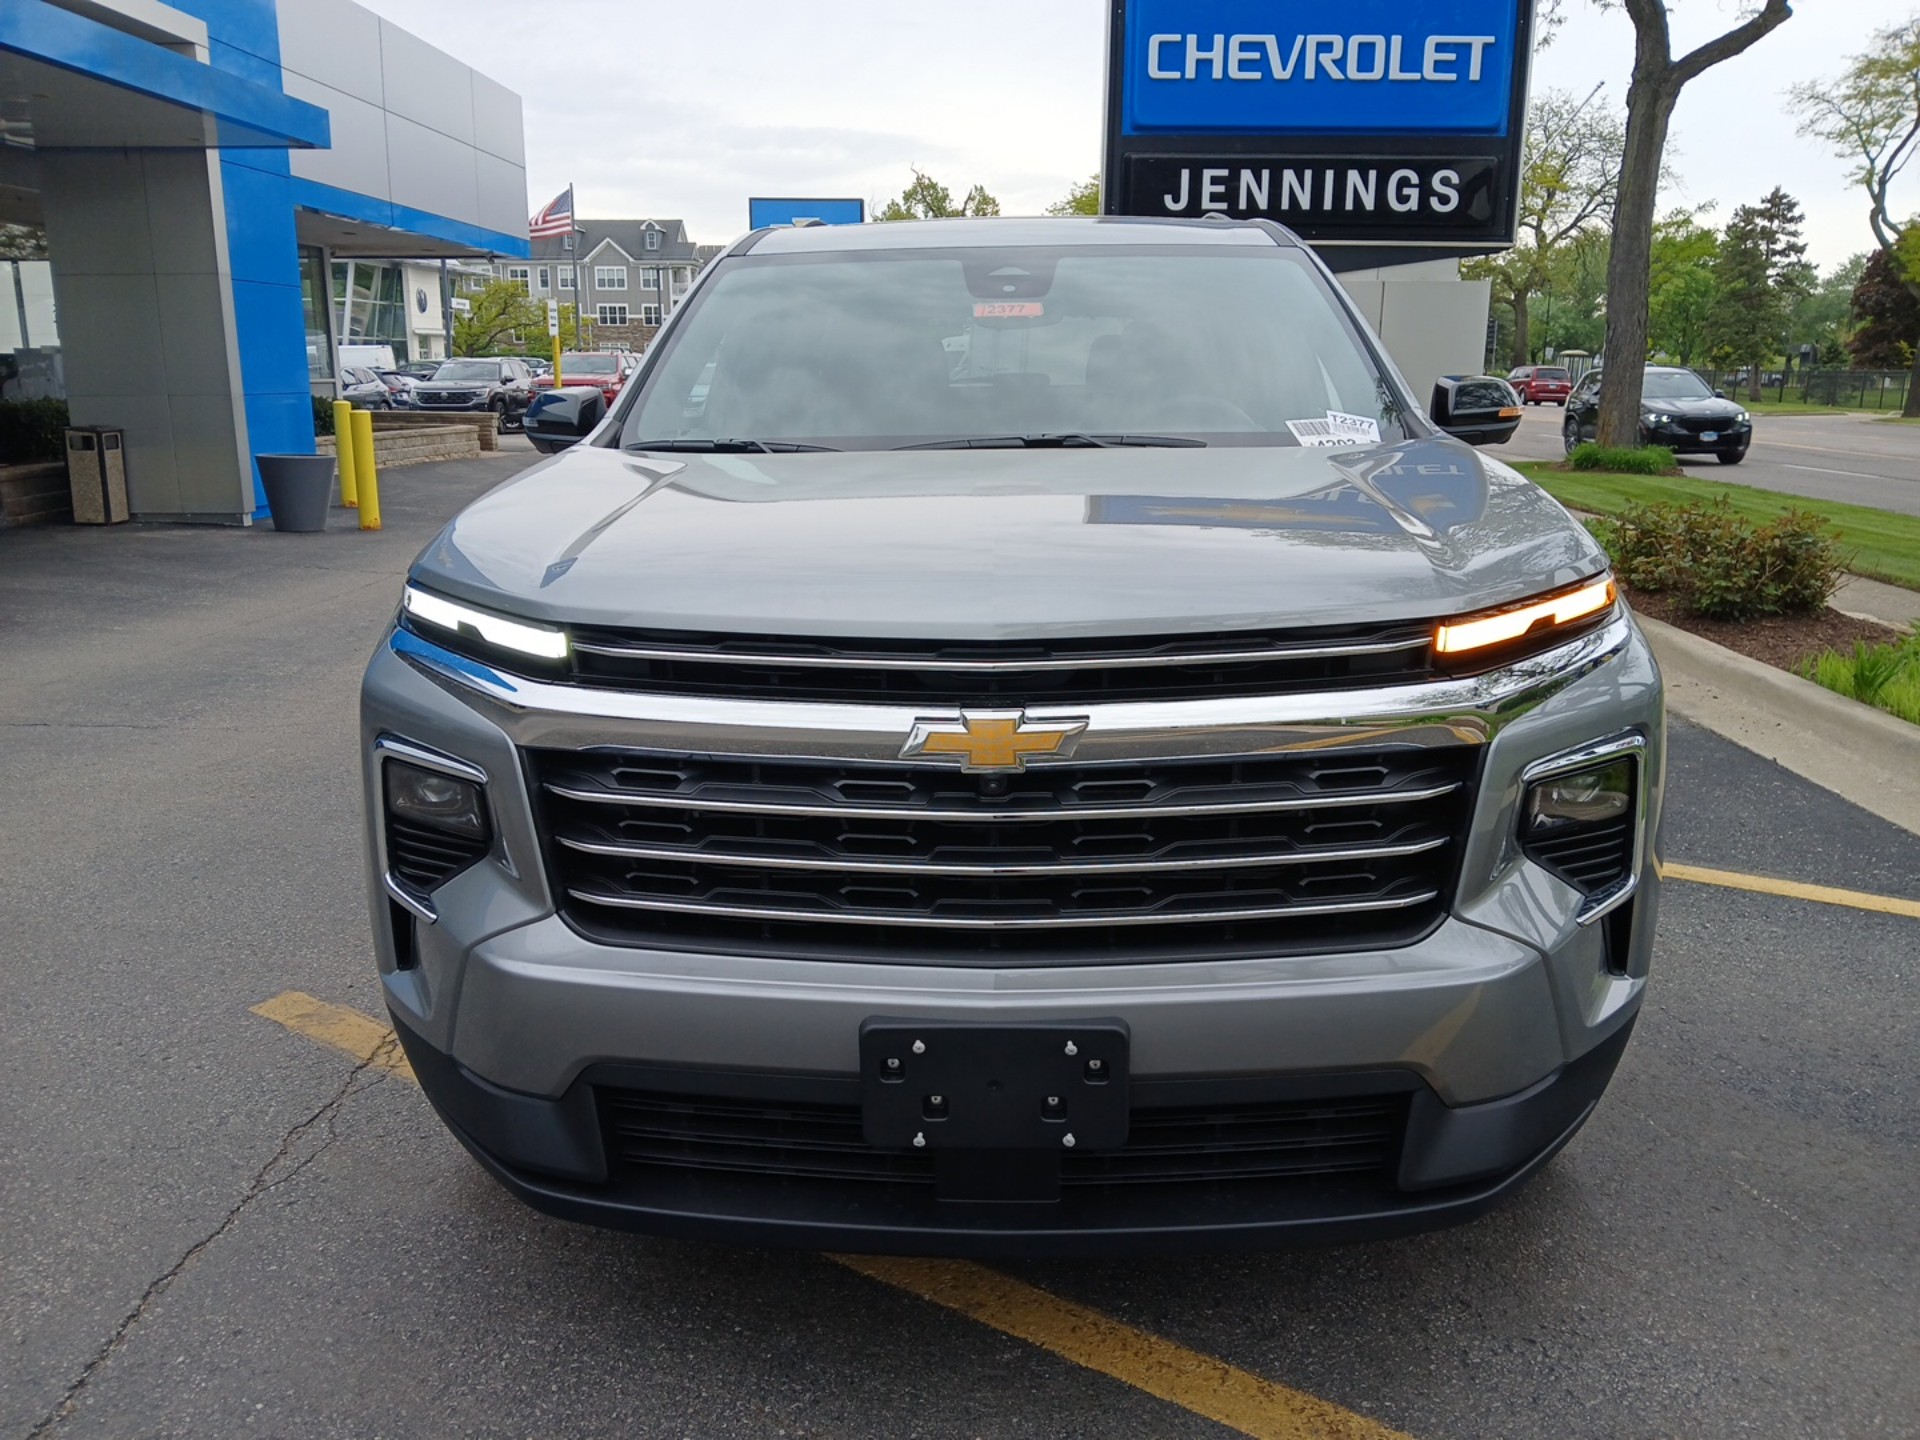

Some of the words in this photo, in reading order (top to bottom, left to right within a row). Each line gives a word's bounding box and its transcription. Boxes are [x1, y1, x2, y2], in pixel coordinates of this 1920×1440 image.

[1148, 34, 1495, 81] CHEVROLET
[1164, 168, 1461, 213] JENNINGS
[1330, 414, 1374, 429] T2377
